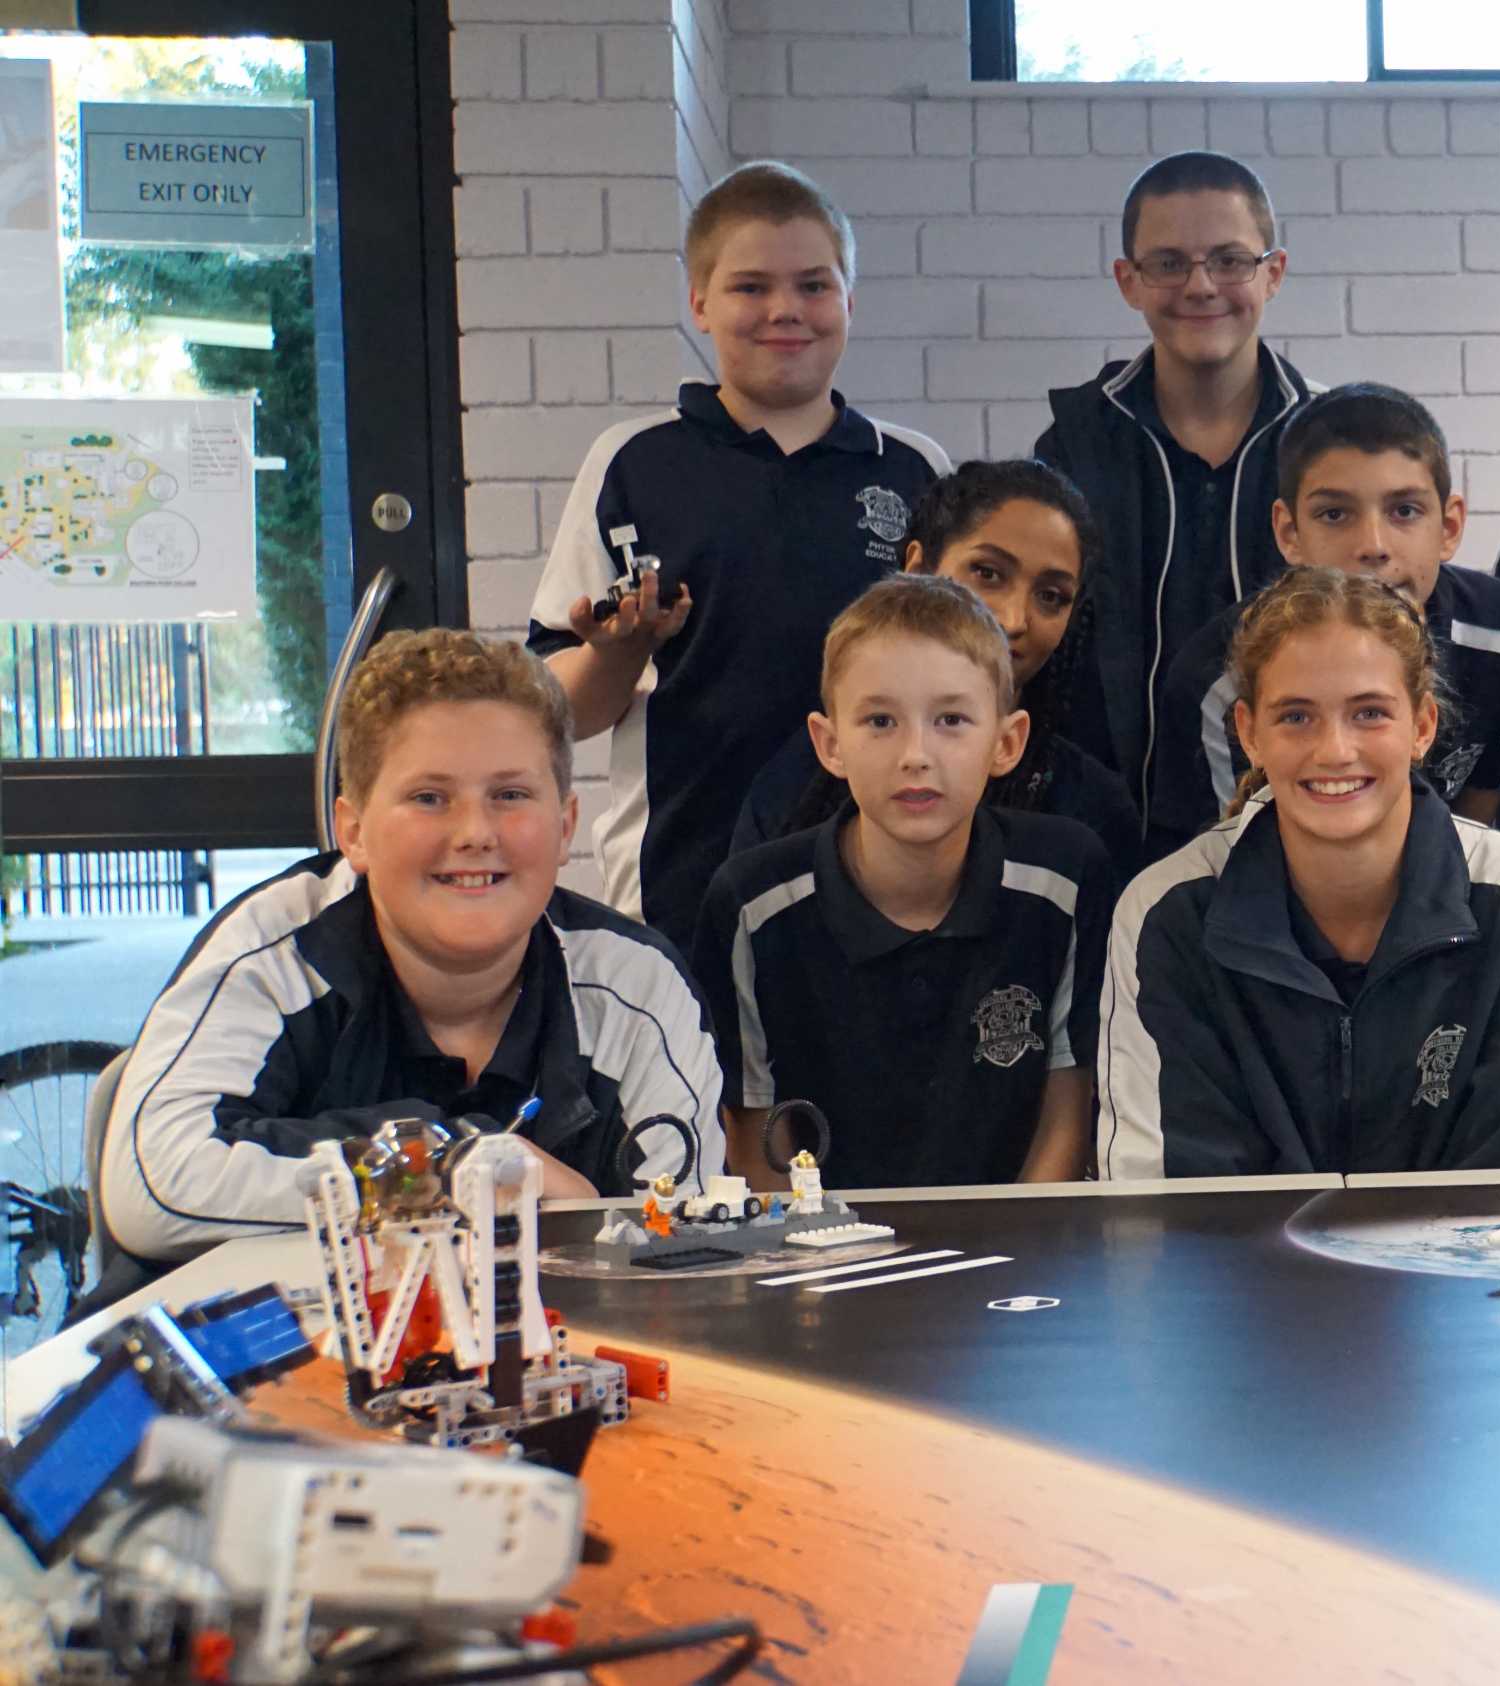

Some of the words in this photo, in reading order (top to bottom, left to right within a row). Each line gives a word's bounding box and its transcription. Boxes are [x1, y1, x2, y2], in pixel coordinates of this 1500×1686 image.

[124, 142, 267, 164] EMERGENCY
[139, 182, 186, 201] EXIT
[193, 183, 254, 204] ONLY
